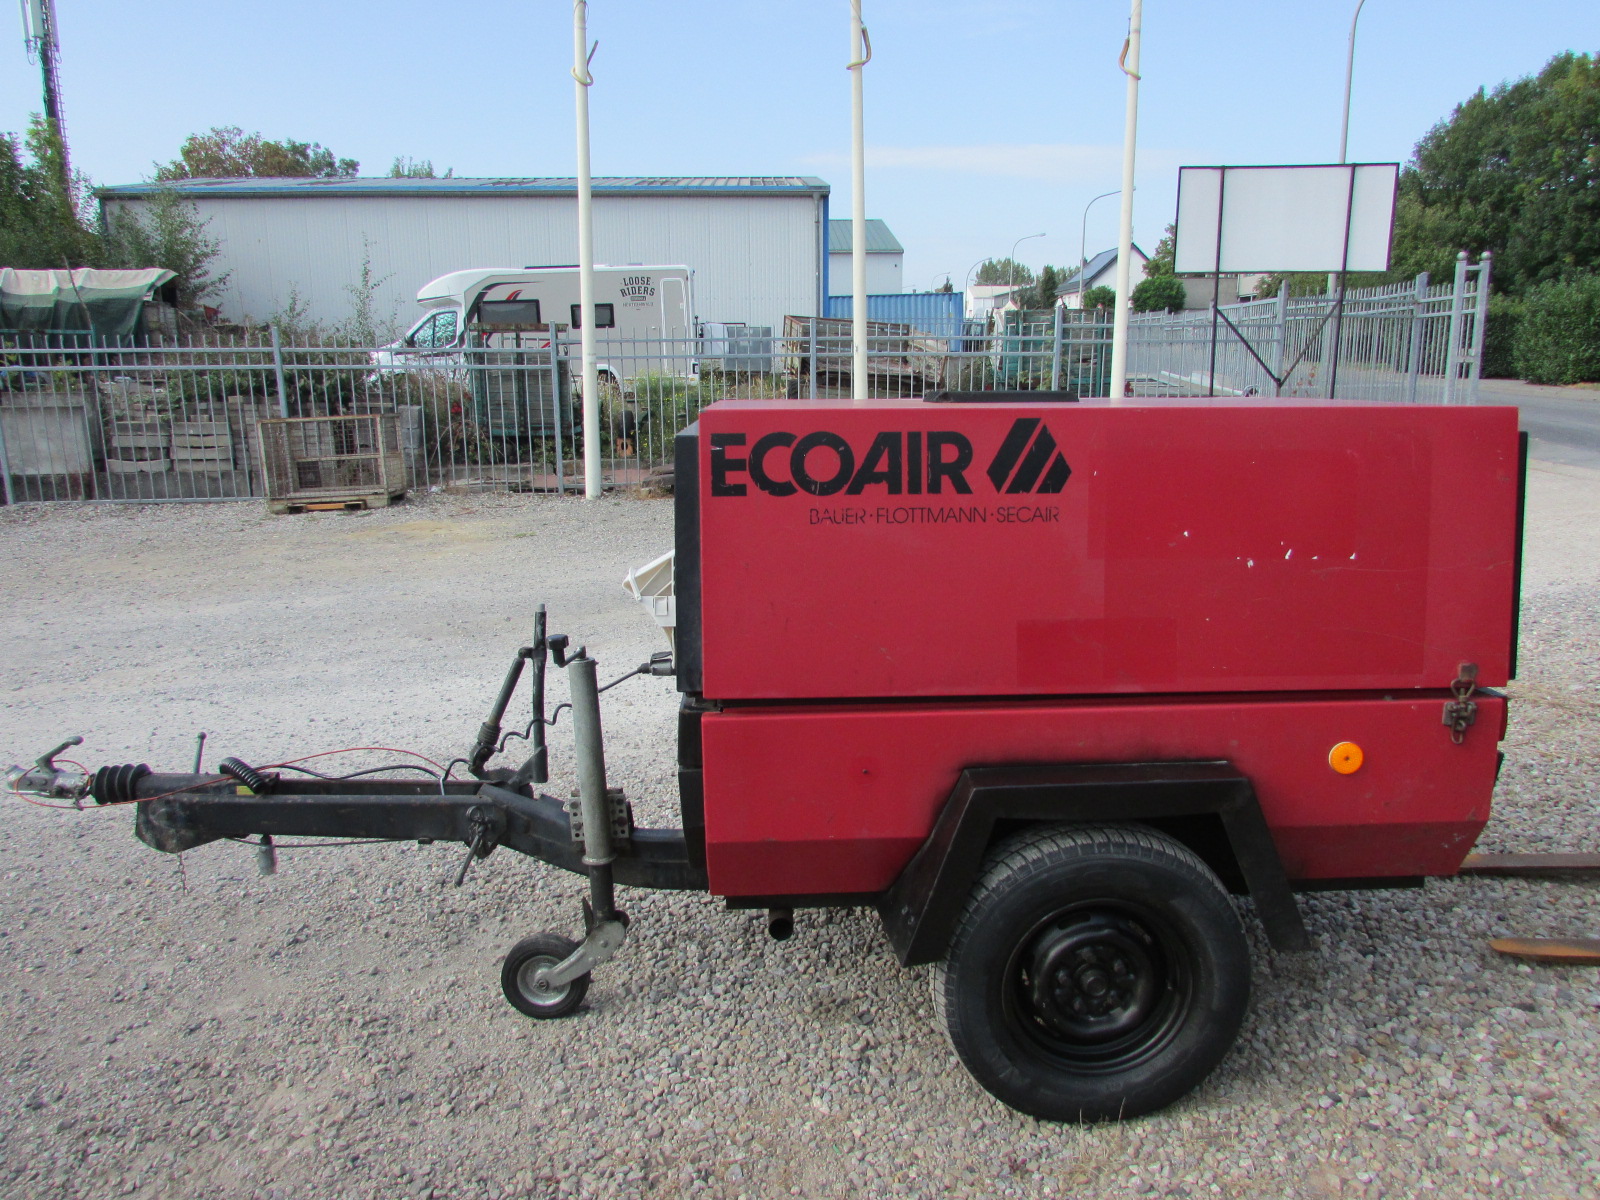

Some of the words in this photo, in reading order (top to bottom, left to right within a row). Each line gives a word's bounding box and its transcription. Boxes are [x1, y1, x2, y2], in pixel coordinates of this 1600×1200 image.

[623, 276, 651, 286] LOOSE
[620, 286, 655, 297] RIDERS
[711, 431, 974, 496] ECOAIR
[810, 508, 867, 525] BAUER
[876, 507, 987, 524] FLOTTMANN
[996, 506, 1060, 523] SECAIR
